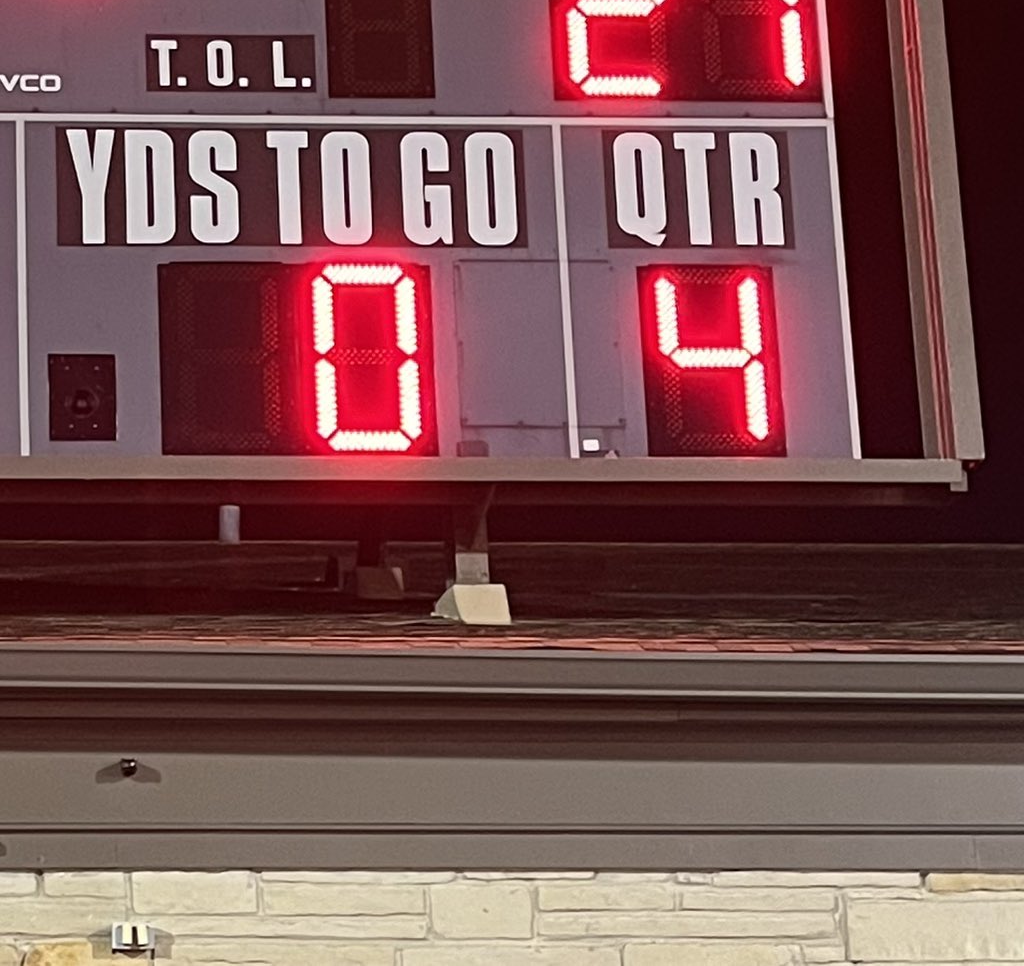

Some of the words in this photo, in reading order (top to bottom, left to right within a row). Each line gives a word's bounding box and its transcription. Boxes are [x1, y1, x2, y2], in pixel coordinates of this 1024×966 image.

[65, 128, 240, 246] YDS
[266, 129, 375, 246] TO
[399, 131, 520, 247] GO
[611, 131, 785, 248] QTR
[310, 262, 423, 452] 0
[653, 275, 771, 442] 4
